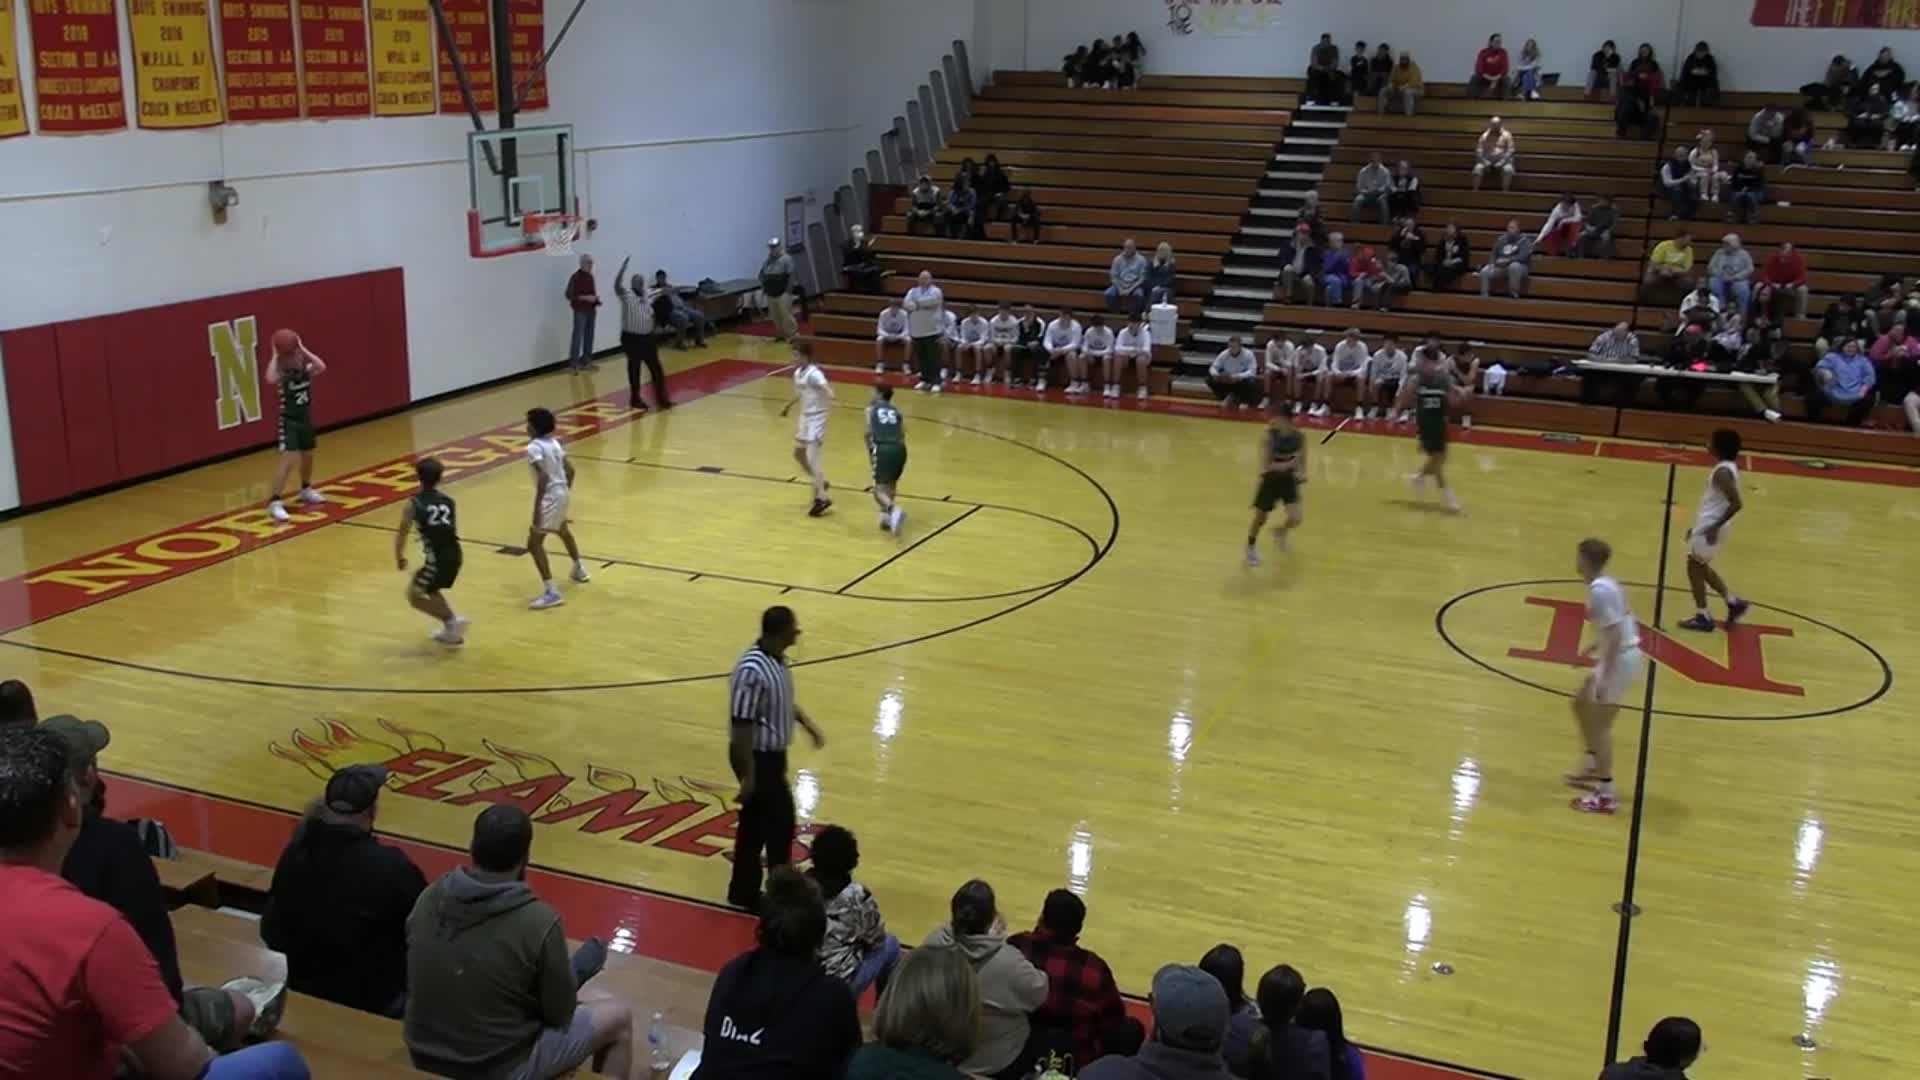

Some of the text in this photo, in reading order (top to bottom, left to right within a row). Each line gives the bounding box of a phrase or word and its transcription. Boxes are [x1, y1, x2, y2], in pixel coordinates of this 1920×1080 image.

[207, 315, 262, 430] N
[426, 504, 451, 526] 22
[1506, 595, 1806, 697] N
[380, 746, 833, 868] FLAME
